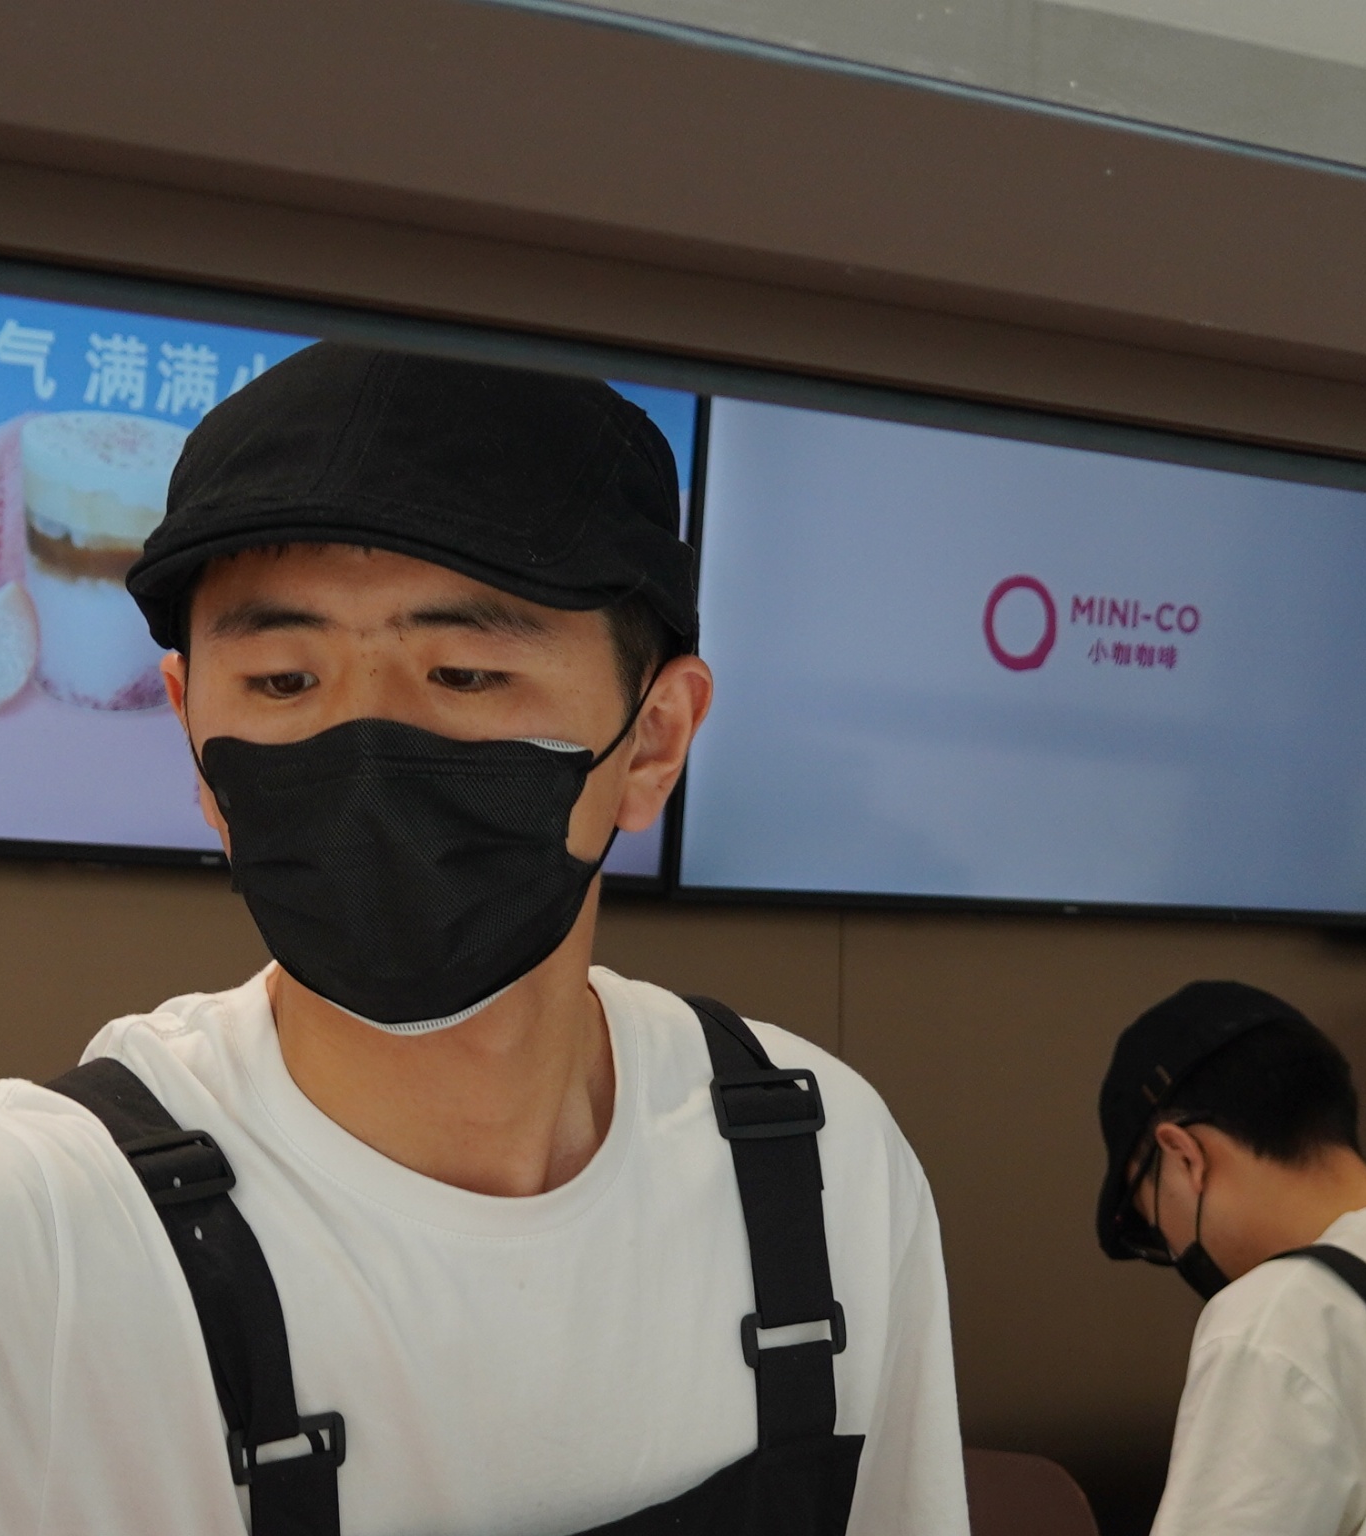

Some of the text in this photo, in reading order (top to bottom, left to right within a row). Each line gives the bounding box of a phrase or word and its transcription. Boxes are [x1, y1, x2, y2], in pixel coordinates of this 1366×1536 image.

[1070, 594, 1201, 634] MINI-CO
[1088, 638, 1177, 669] 小咖咖啡
